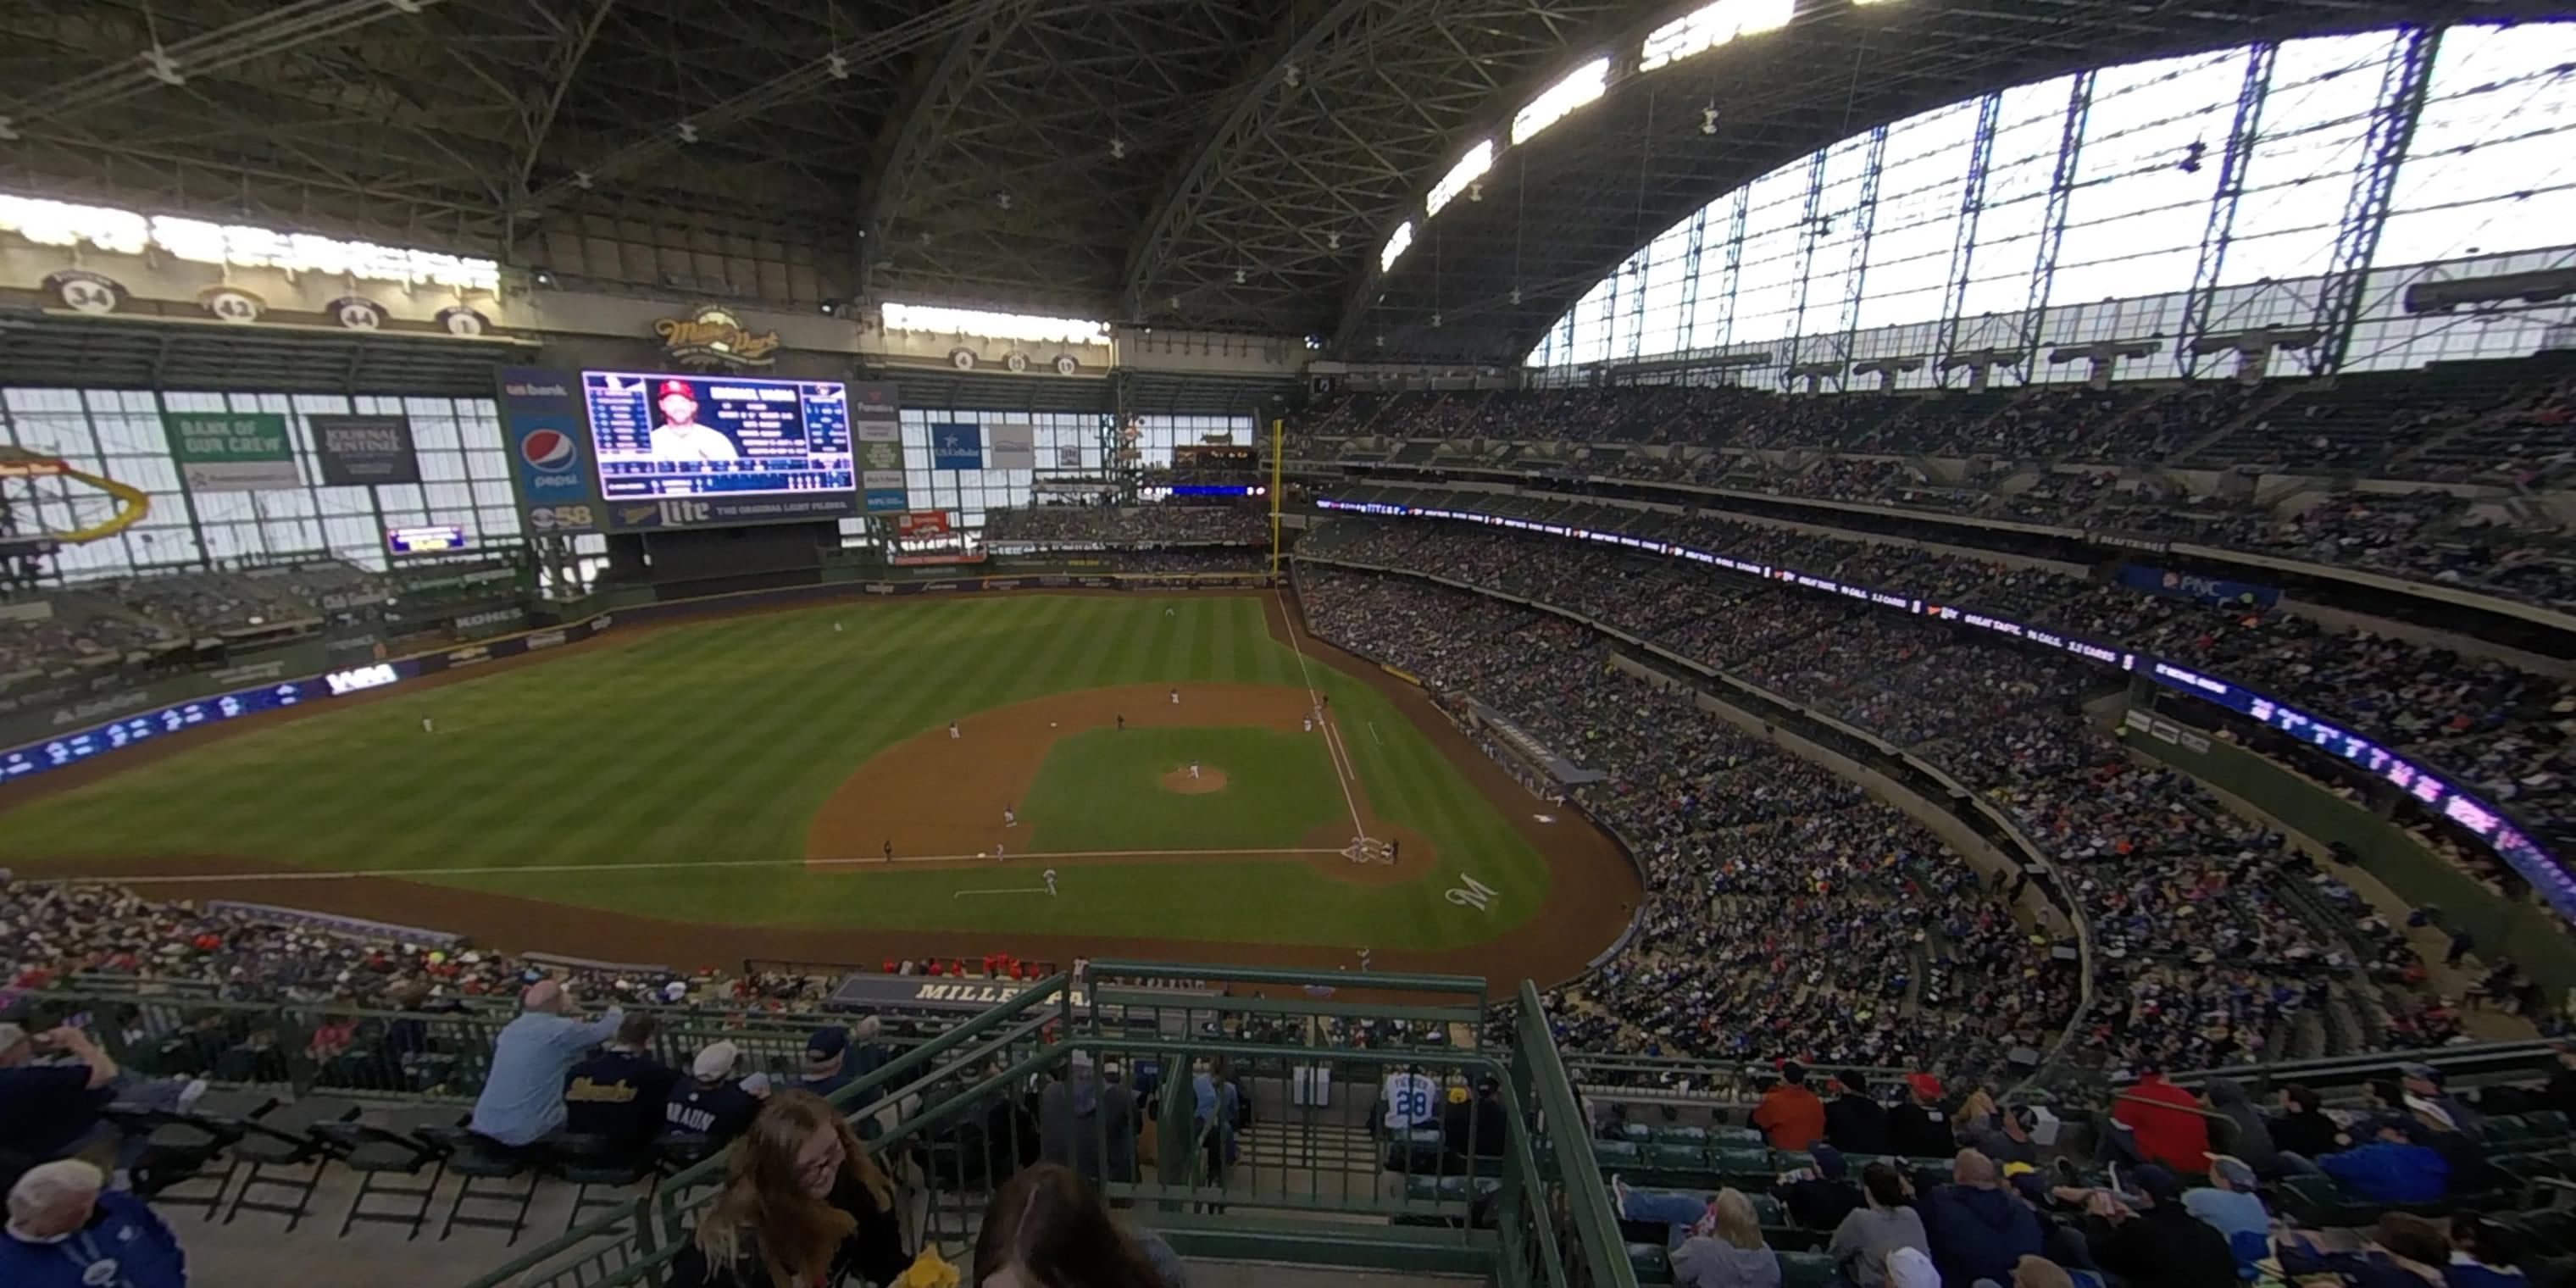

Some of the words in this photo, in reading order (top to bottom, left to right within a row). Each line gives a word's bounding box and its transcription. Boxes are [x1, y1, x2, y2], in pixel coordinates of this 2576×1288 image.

[69, 286, 108, 306] 34
[347, 310, 374, 326] 44
[180, 421, 230, 436] BANK
[235, 421, 255, 436] OF
[325, 429, 399, 441] JOURNAL
[186, 437, 225, 453] OUR
[229, 436, 282, 452] CREW
[326, 440, 402, 452] SENTINEL
[535, 475, 580, 488] pepsi
[555, 506, 592, 527] 58
[658, 501, 710, 527] Lite
[715, 506, 736, 516] THE
[2180, 576, 2222, 597] PNC
[1445, 872, 1499, 912] M
[916, 984, 1022, 1003] MILLE
[1396, 1090, 1427, 1117] 28
